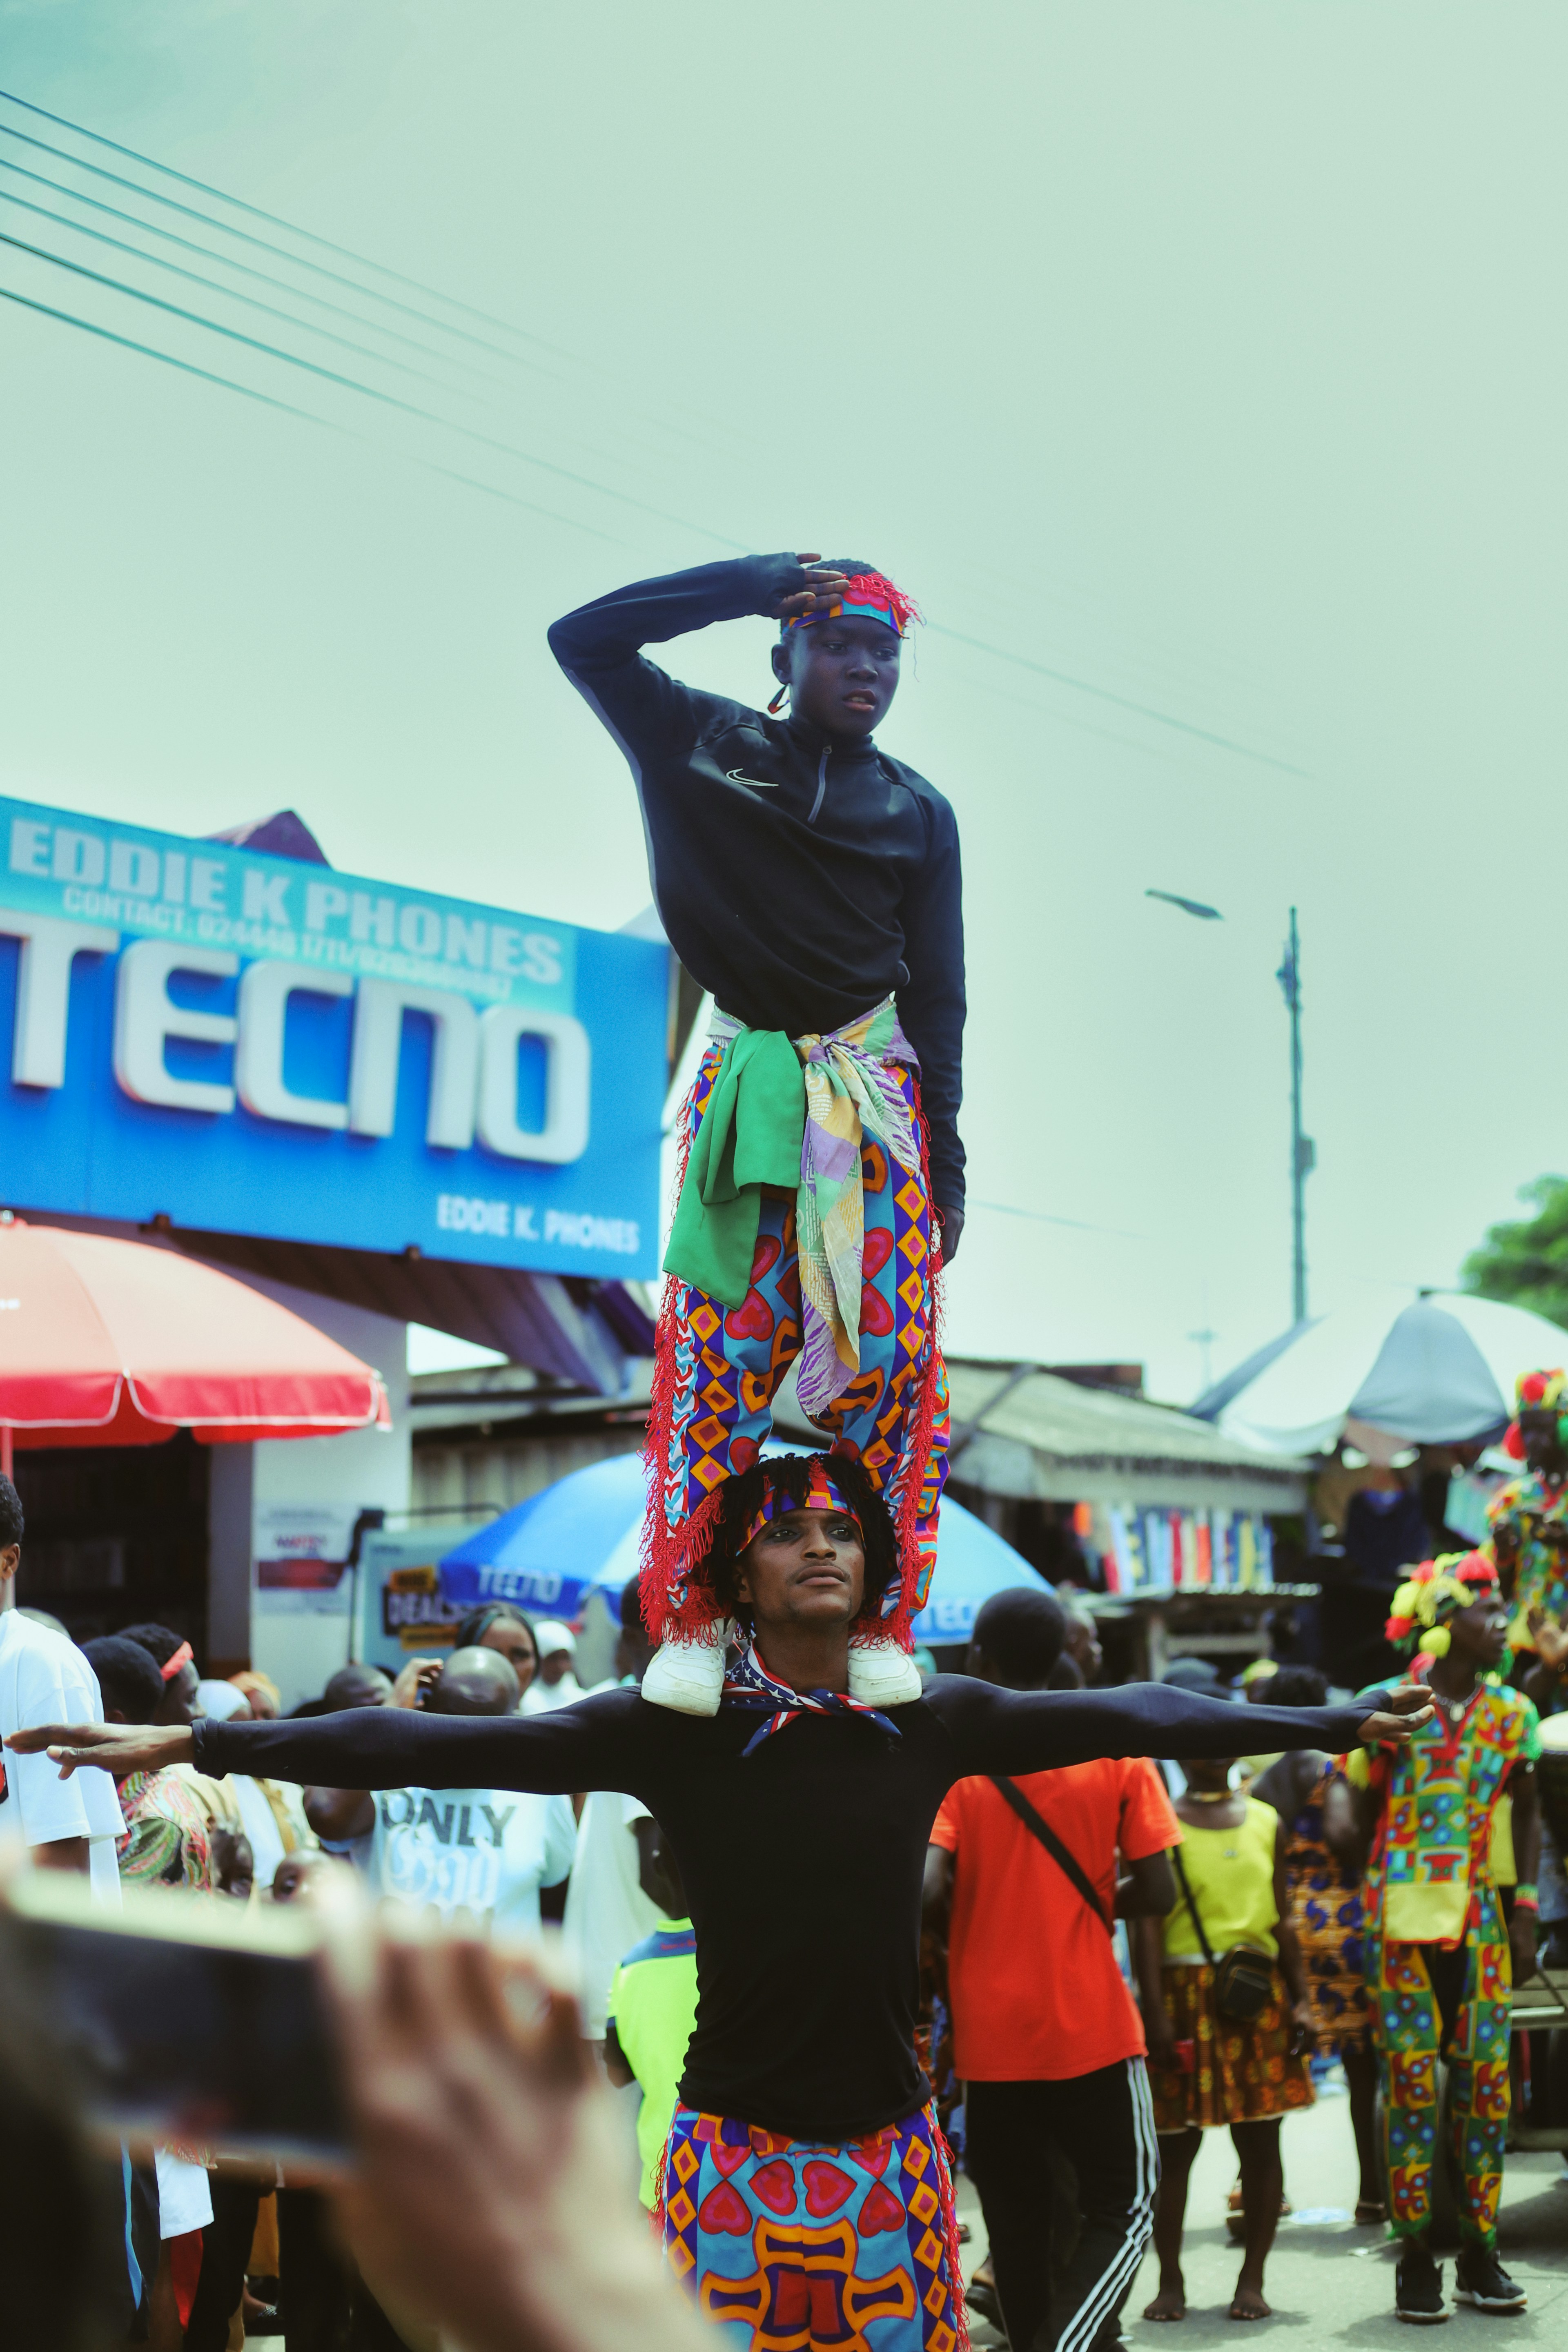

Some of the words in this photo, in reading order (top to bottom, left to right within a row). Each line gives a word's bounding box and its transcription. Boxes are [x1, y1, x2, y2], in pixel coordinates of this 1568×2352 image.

[9, 818, 227, 913] EDDIE
[244, 869, 292, 927] K
[304, 879, 562, 984] PHONES
[0, 907, 591, 1166] TECNO
[436, 1193, 510, 1238] EDDIE
[545, 1208, 640, 1255] PHONES
[920, 1598, 981, 1632] TEC
[381, 1788, 515, 1848] ONLY
